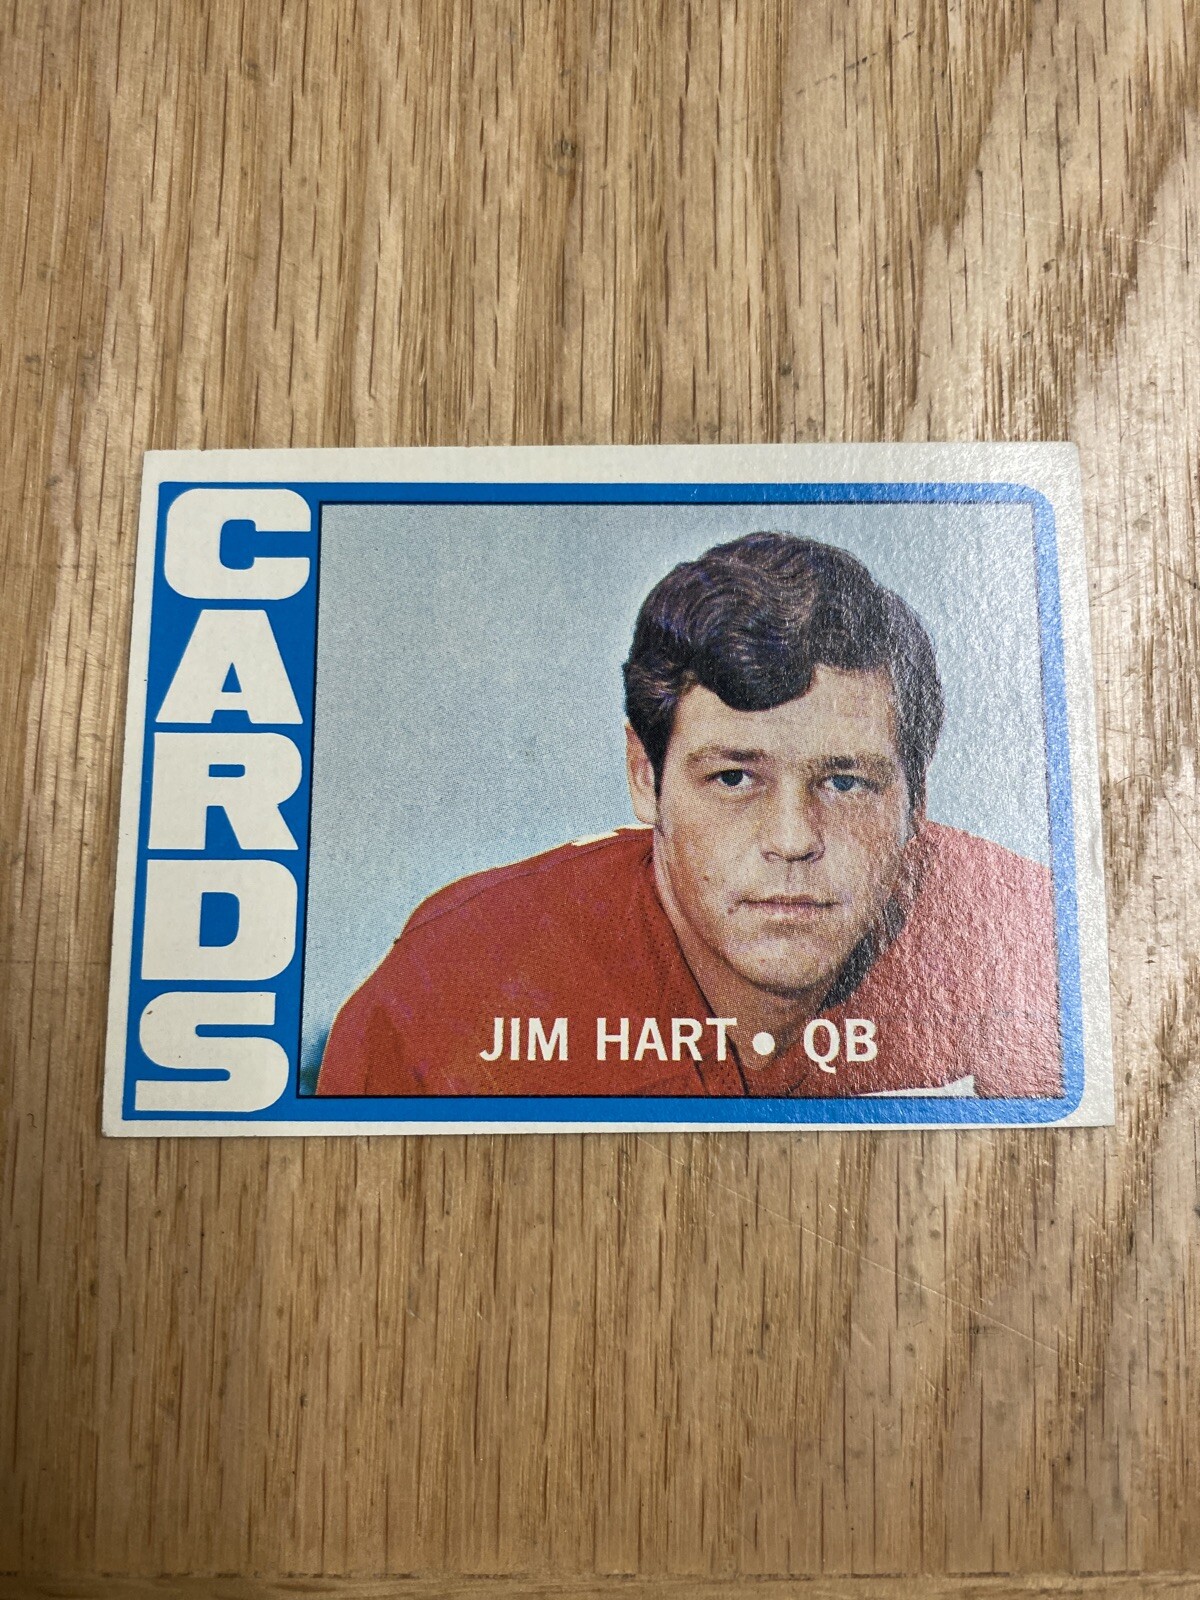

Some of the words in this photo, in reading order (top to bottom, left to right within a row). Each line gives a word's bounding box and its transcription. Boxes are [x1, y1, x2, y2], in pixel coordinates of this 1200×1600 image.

[135, 488, 311, 1113] CARDS
[479, 1017, 568, 1062] JIM
[596, 1016, 738, 1062] HART
[803, 1015, 879, 1076] QB
